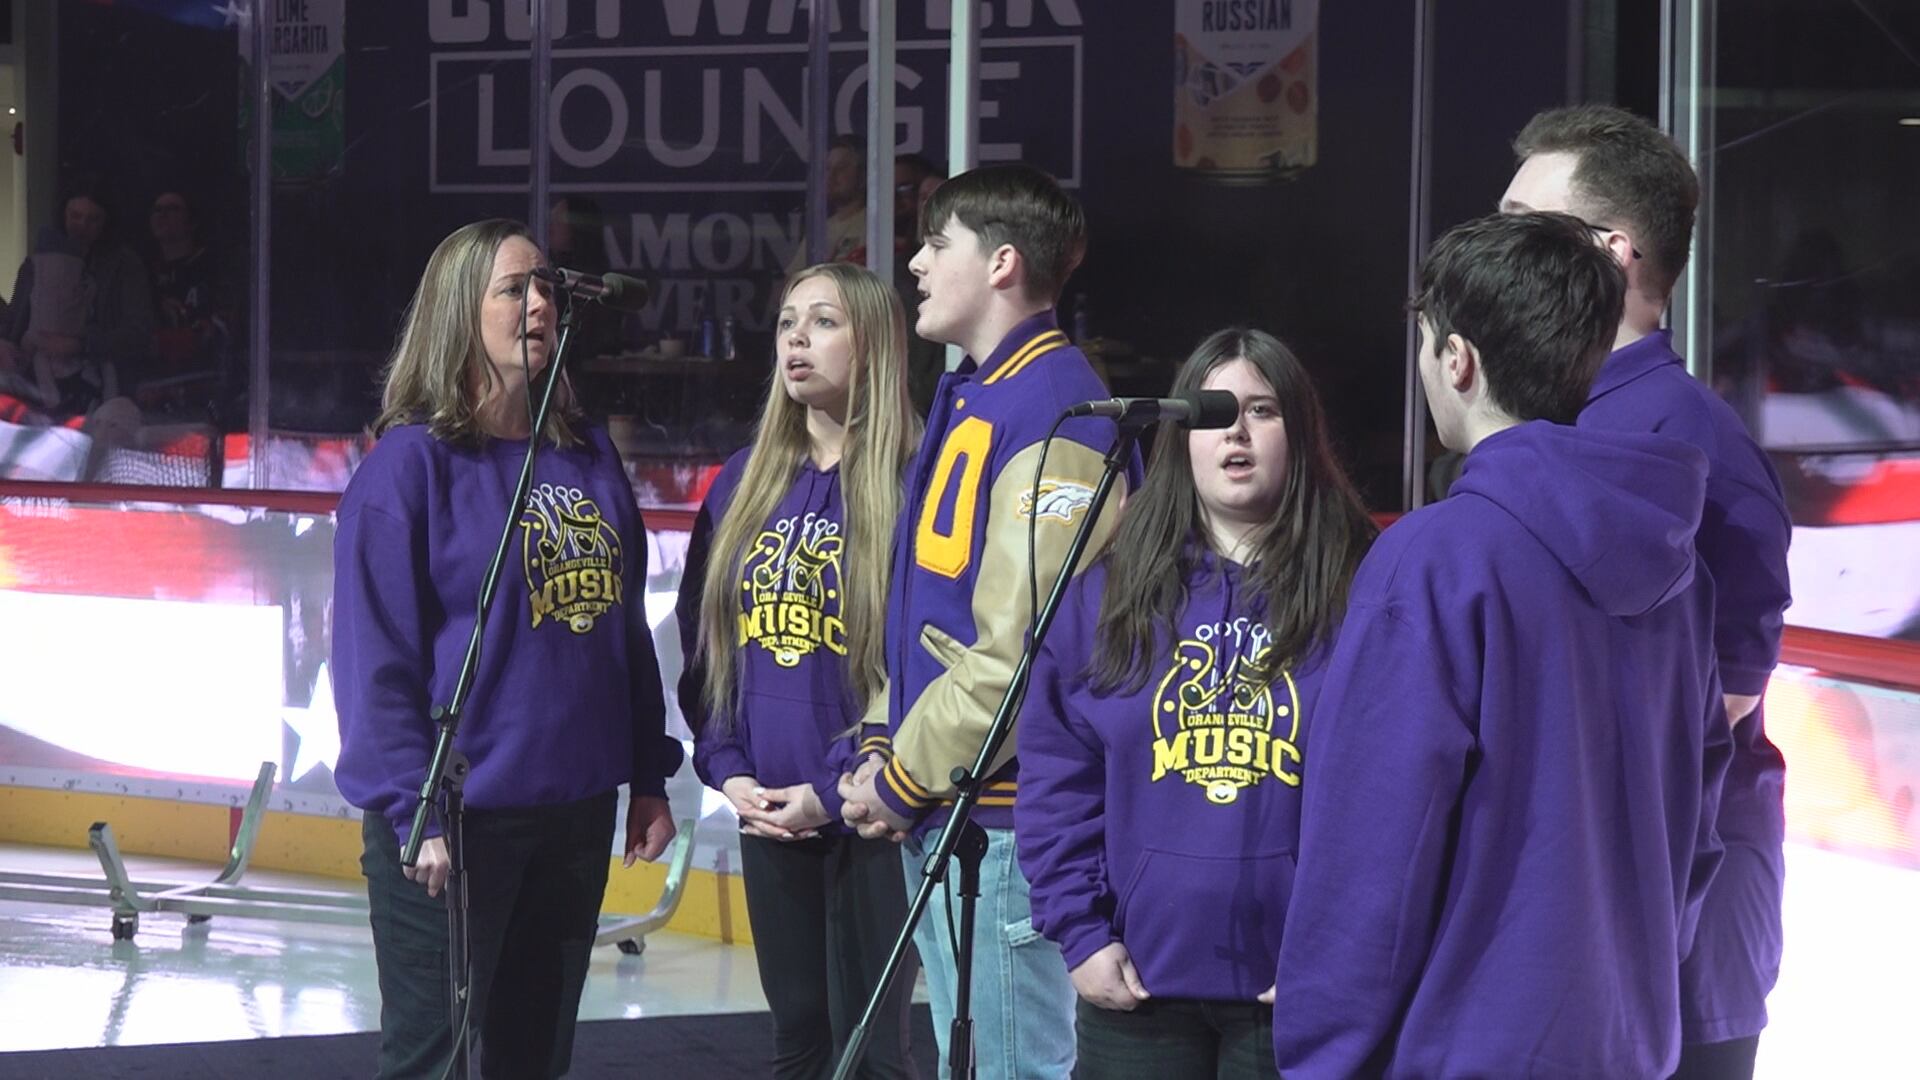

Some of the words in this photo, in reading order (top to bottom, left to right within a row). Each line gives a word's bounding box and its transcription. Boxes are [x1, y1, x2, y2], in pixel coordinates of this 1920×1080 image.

[1202, 0, 1293, 32] RUSSIAN
[477, 60, 1023, 168] LOUNGE
[759, 591, 818, 608] ORAGEVILLE
[738, 603, 848, 656] MUSIC
[1187, 713, 1264, 728] ORANEVILLE
[1152, 727, 1301, 787] MUSIC
[1185, 766, 1260, 785] DEPARTMENT
